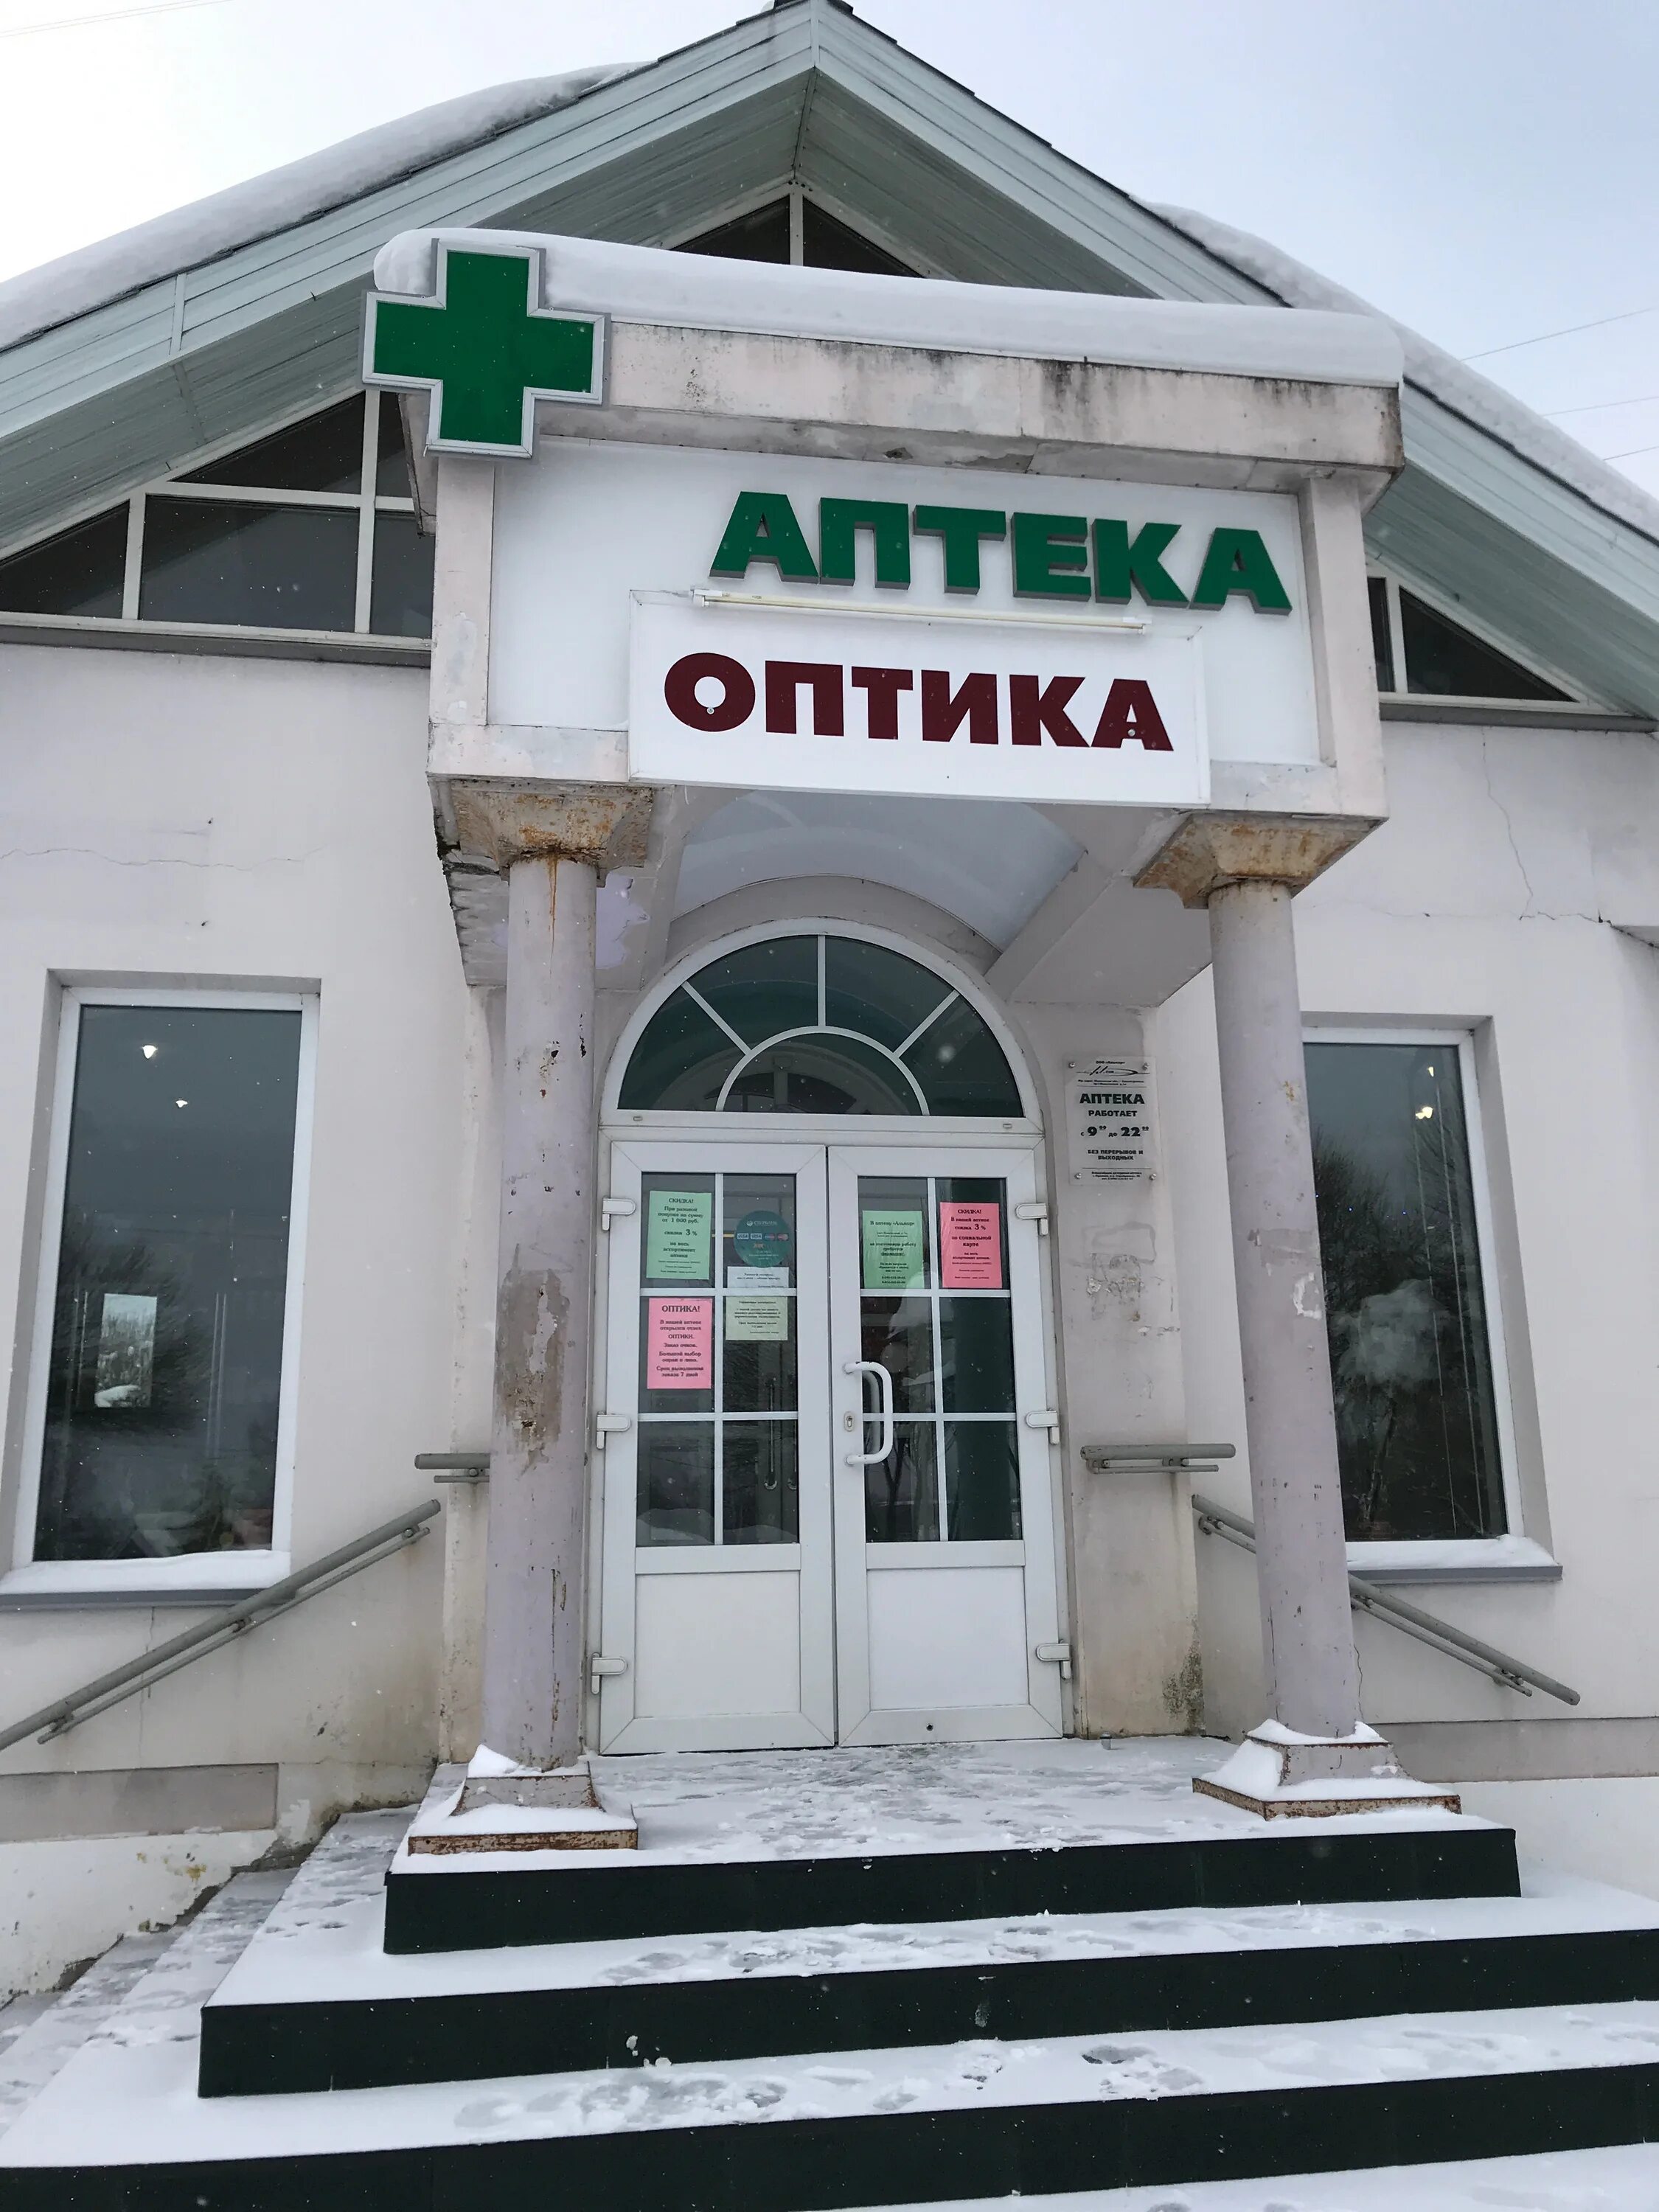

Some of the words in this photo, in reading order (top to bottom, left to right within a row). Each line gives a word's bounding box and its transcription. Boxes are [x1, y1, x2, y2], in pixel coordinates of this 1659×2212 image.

[709, 491, 1293, 616] АПТЕКА
[664, 652, 1174, 752] ОПТИКА
[1079, 1093, 1145, 1104] АПТЕКА
